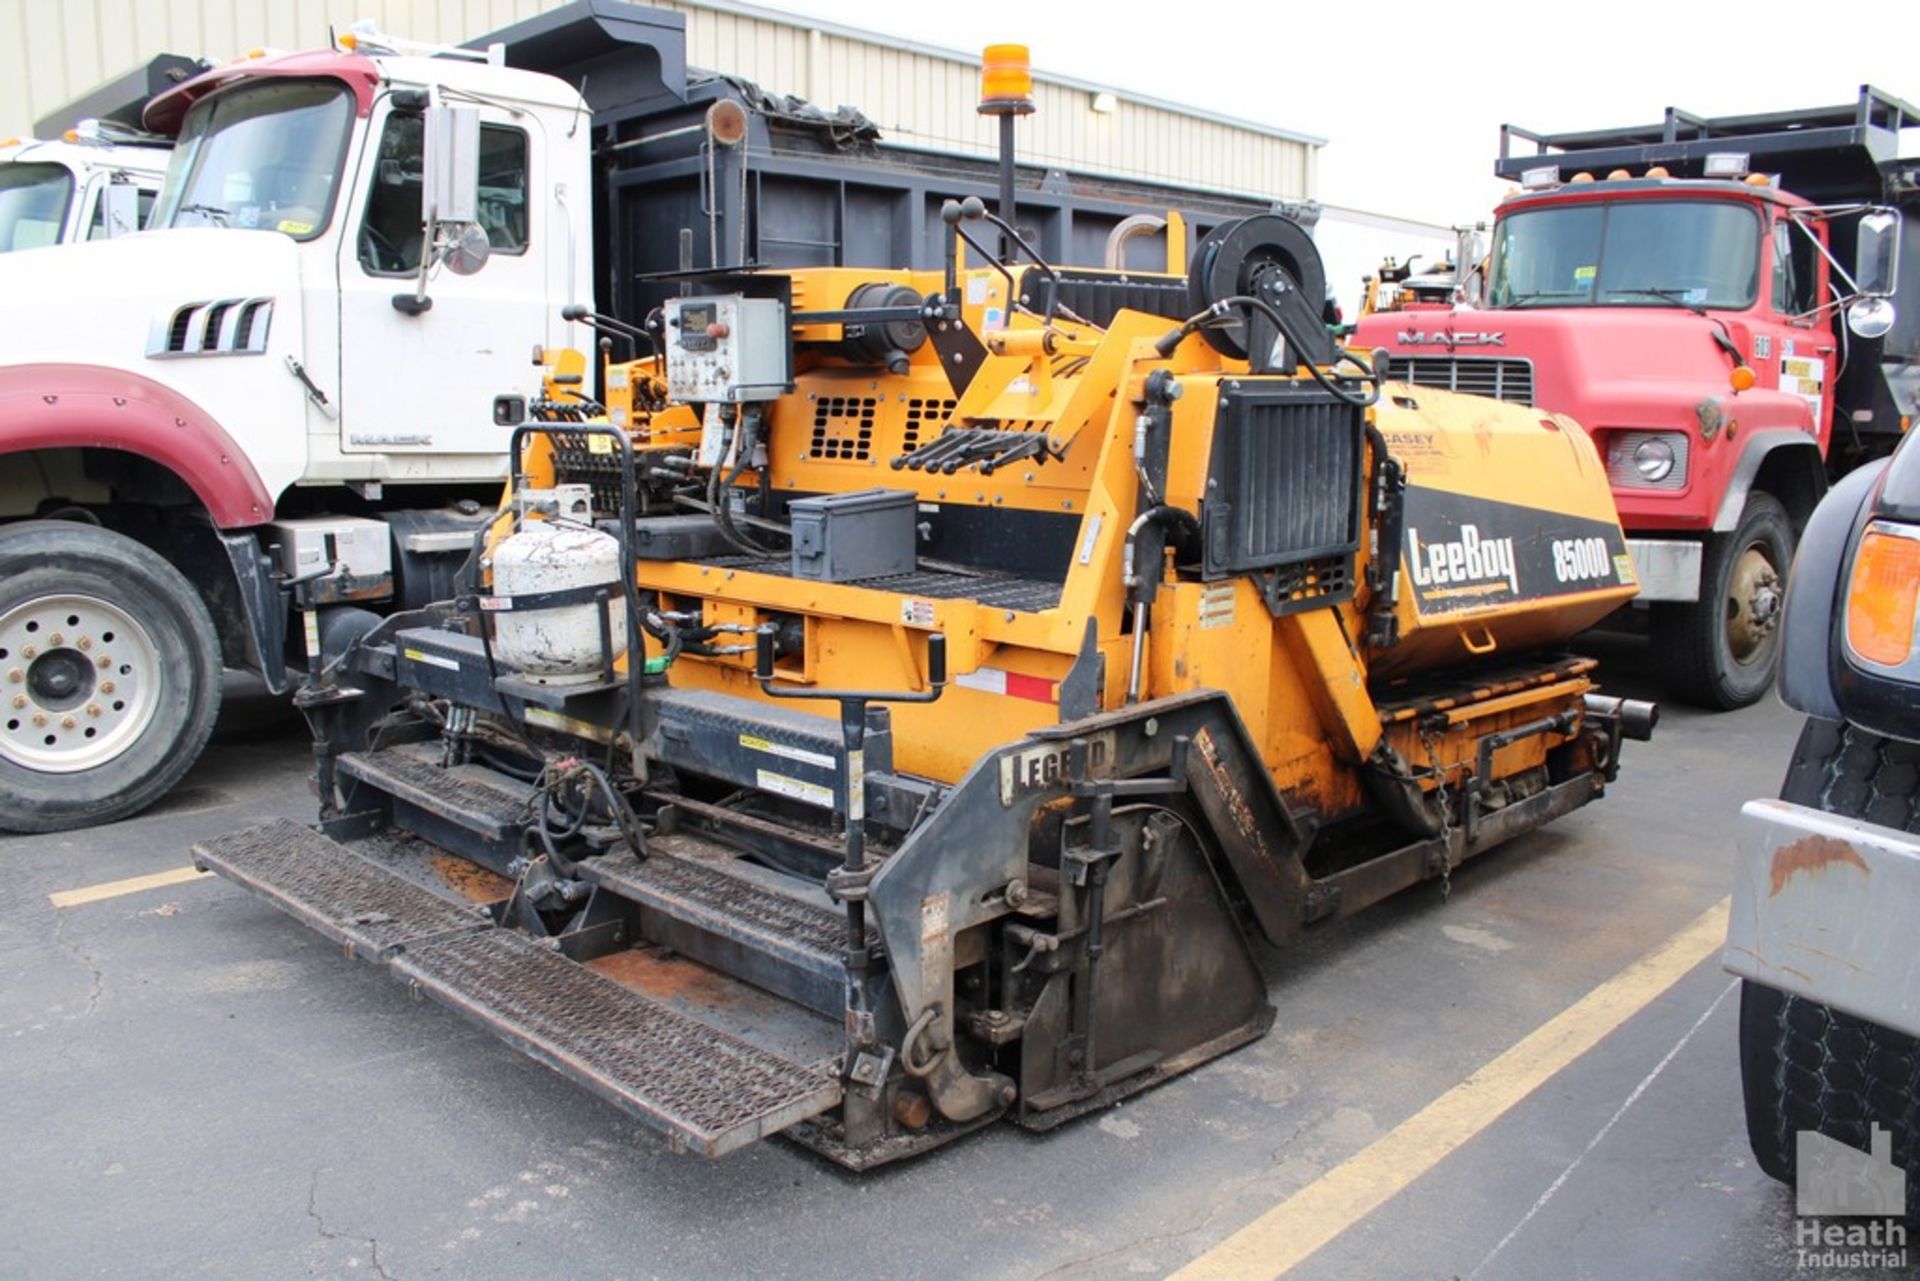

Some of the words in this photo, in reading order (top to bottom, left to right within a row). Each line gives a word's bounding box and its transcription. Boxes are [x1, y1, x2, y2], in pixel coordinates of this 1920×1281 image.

[1397, 331, 1505, 346] MACK
[1408, 525, 1519, 594] LeeBoy
[1552, 537, 1611, 583] 8500D
[1012, 739, 1106, 789] LEGED
